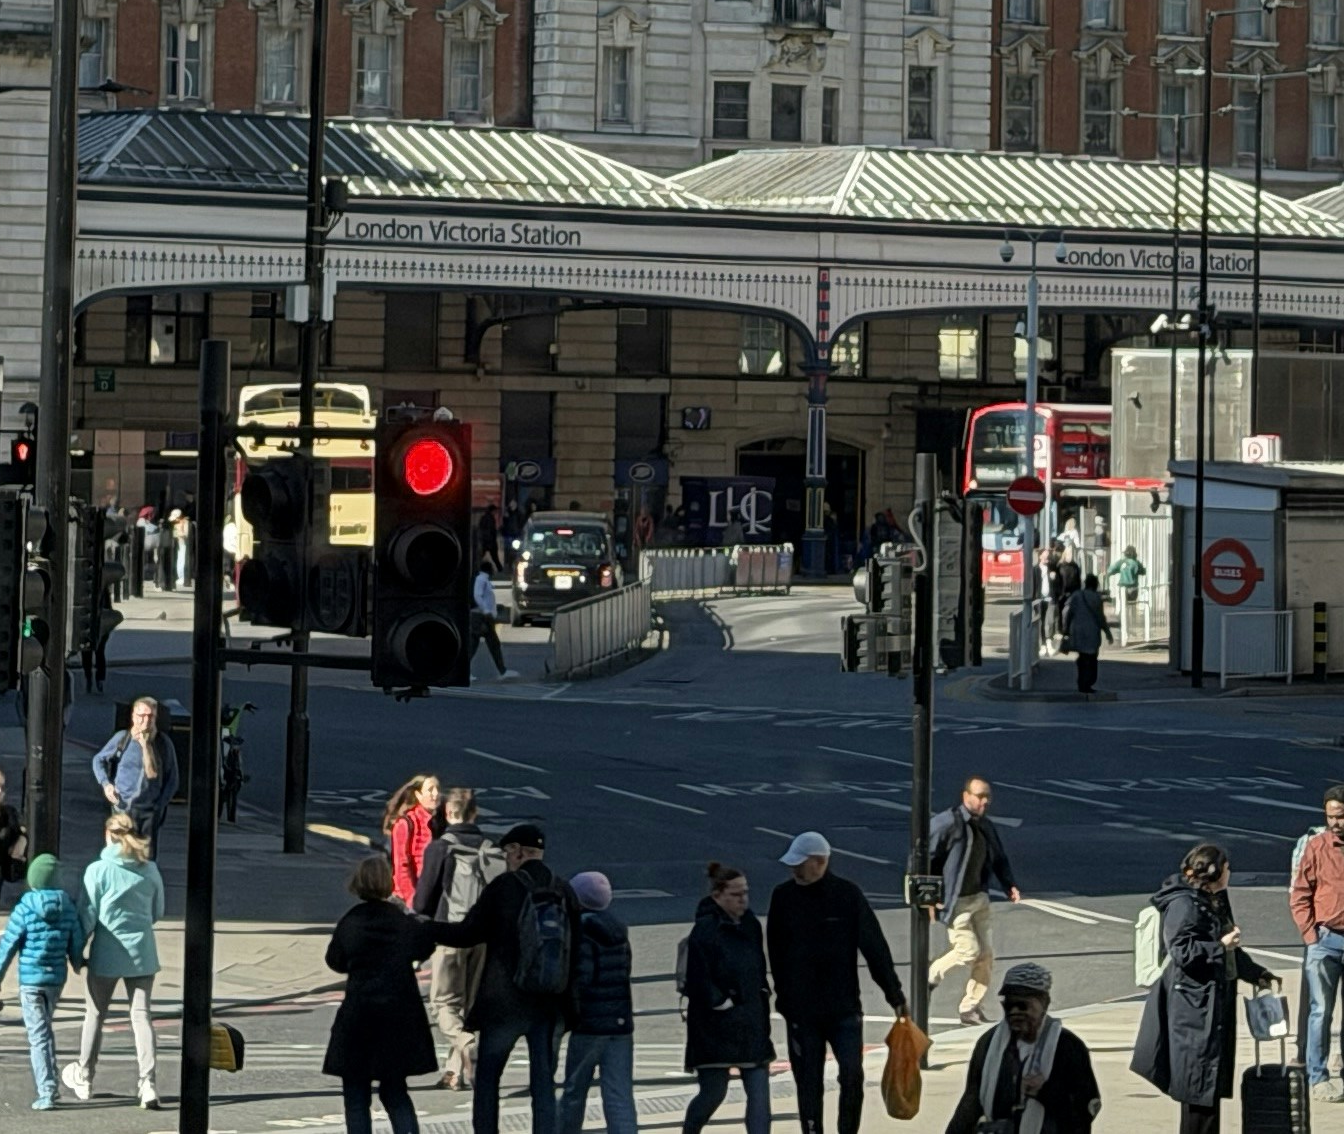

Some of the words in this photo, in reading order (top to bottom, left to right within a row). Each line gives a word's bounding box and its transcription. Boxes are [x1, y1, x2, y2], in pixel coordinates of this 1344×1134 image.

[344, 216, 423, 241] London
[428, 220, 506, 244] Victoria
[510, 222, 582, 247] Station
[1063, 246, 1126, 267] ondon
[1129, 249, 1195, 270] Victoia
